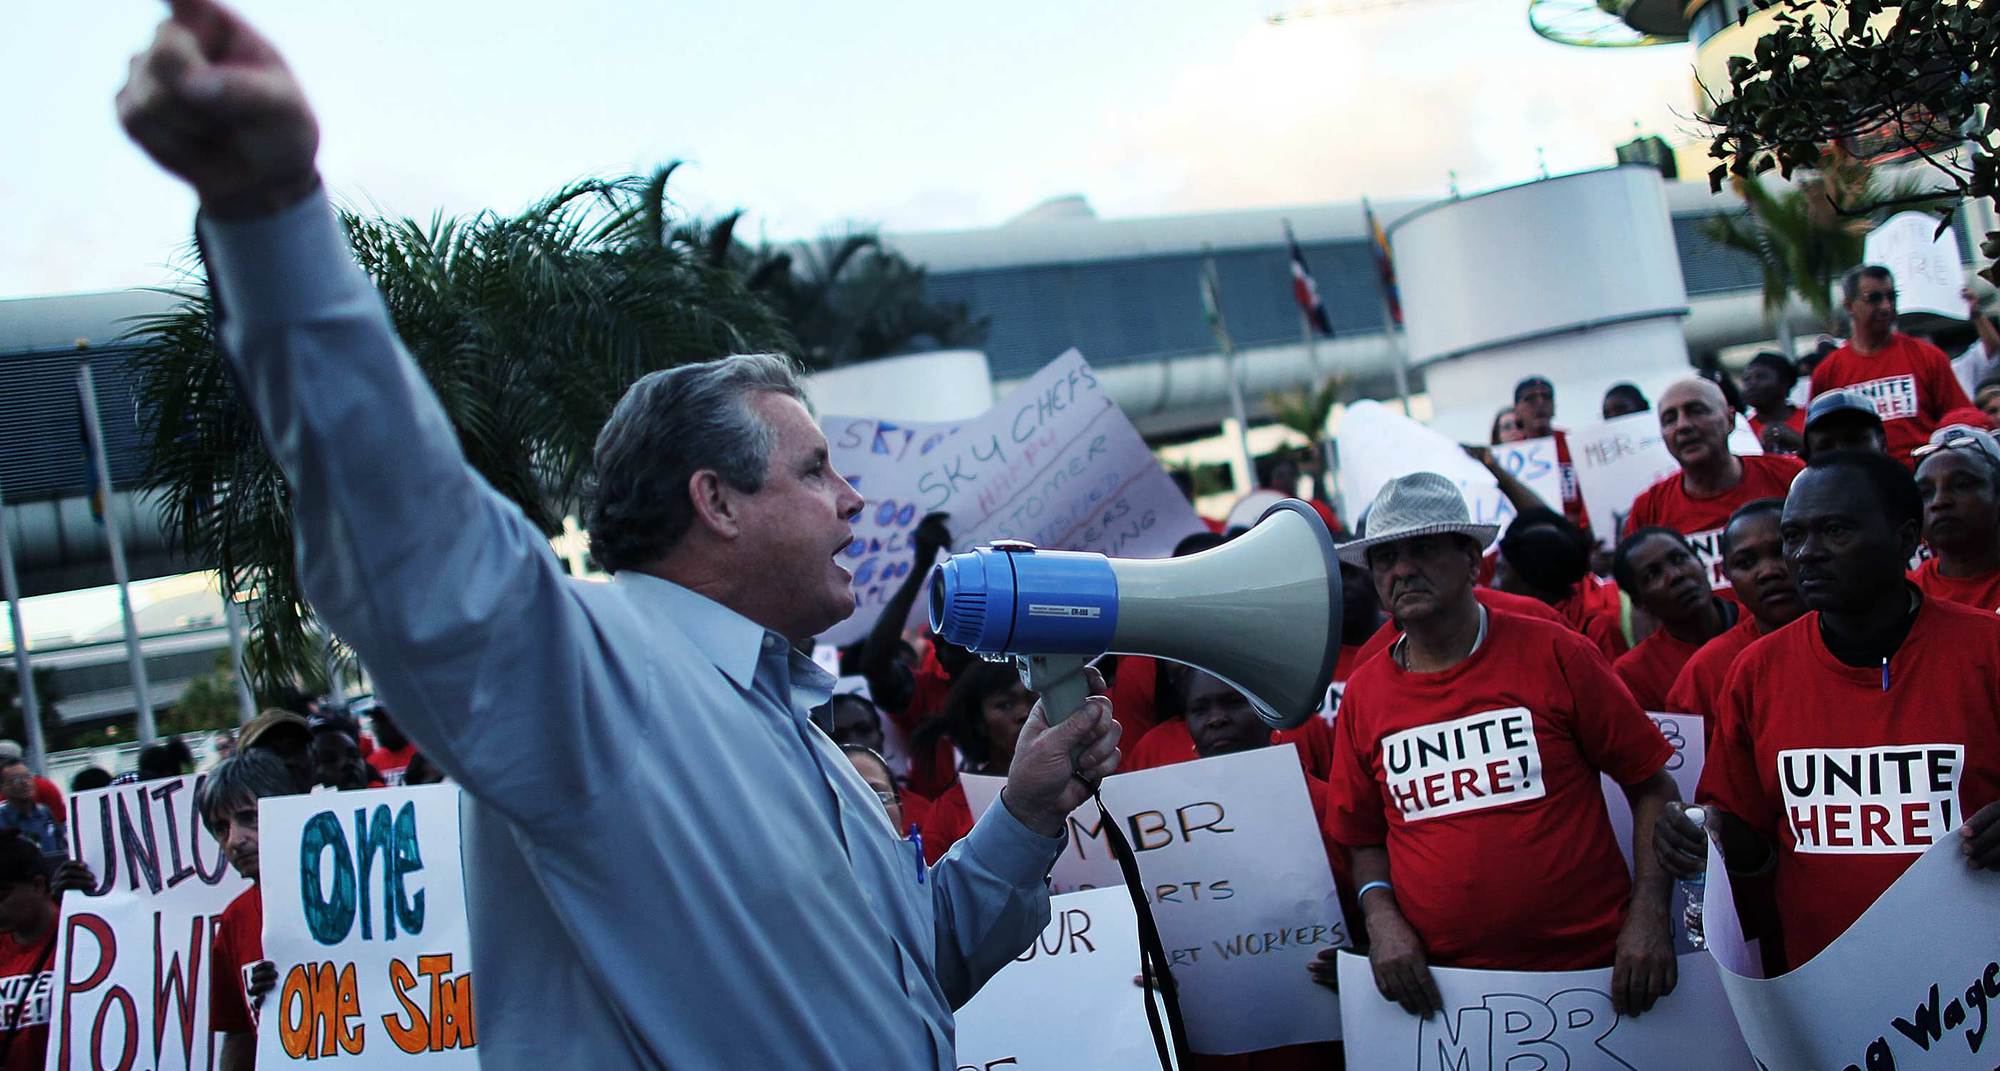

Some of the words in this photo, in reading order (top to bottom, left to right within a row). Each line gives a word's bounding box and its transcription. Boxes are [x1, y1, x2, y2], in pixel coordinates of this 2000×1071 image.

[1012, 366, 1098, 444] CHEFS
[1388, 716, 1527, 775] UNITE
[1784, 750, 1957, 796] UNITE
[1394, 756, 1532, 813] HERE!
[1068, 801, 1235, 861] MBR
[1790, 799, 1953, 847] HERE!
[1213, 922, 1346, 961] WORKERS
[381, 953, 477, 1054] STa
